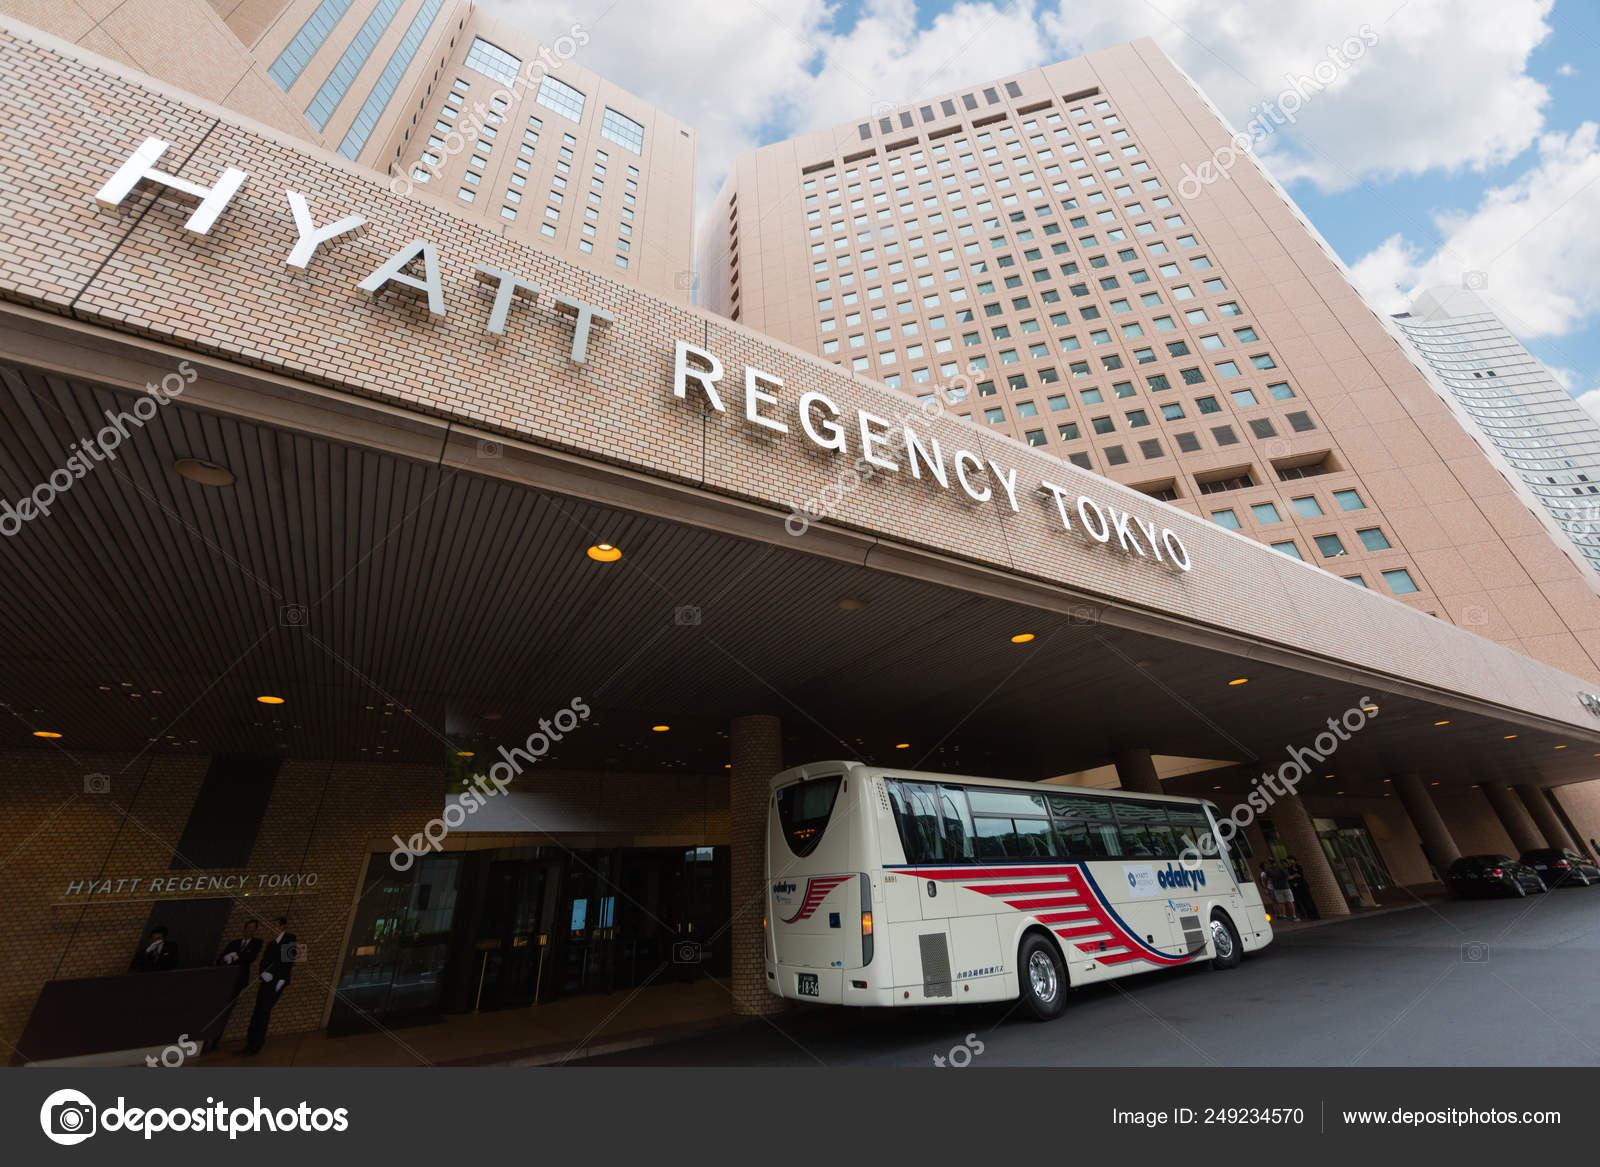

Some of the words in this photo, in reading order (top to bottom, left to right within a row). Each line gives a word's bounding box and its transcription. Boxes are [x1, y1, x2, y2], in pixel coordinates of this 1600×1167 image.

[95, 136, 614, 365] HYATT
[673, 339, 1020, 513] REGENCY
[1040, 479, 1193, 574] TOKYO
[65, 877, 142, 896] HYATT
[149, 875, 250, 893] REGENCY
[257, 872, 319, 889] TOKYO
[1157, 862, 1207, 892] odakyu
